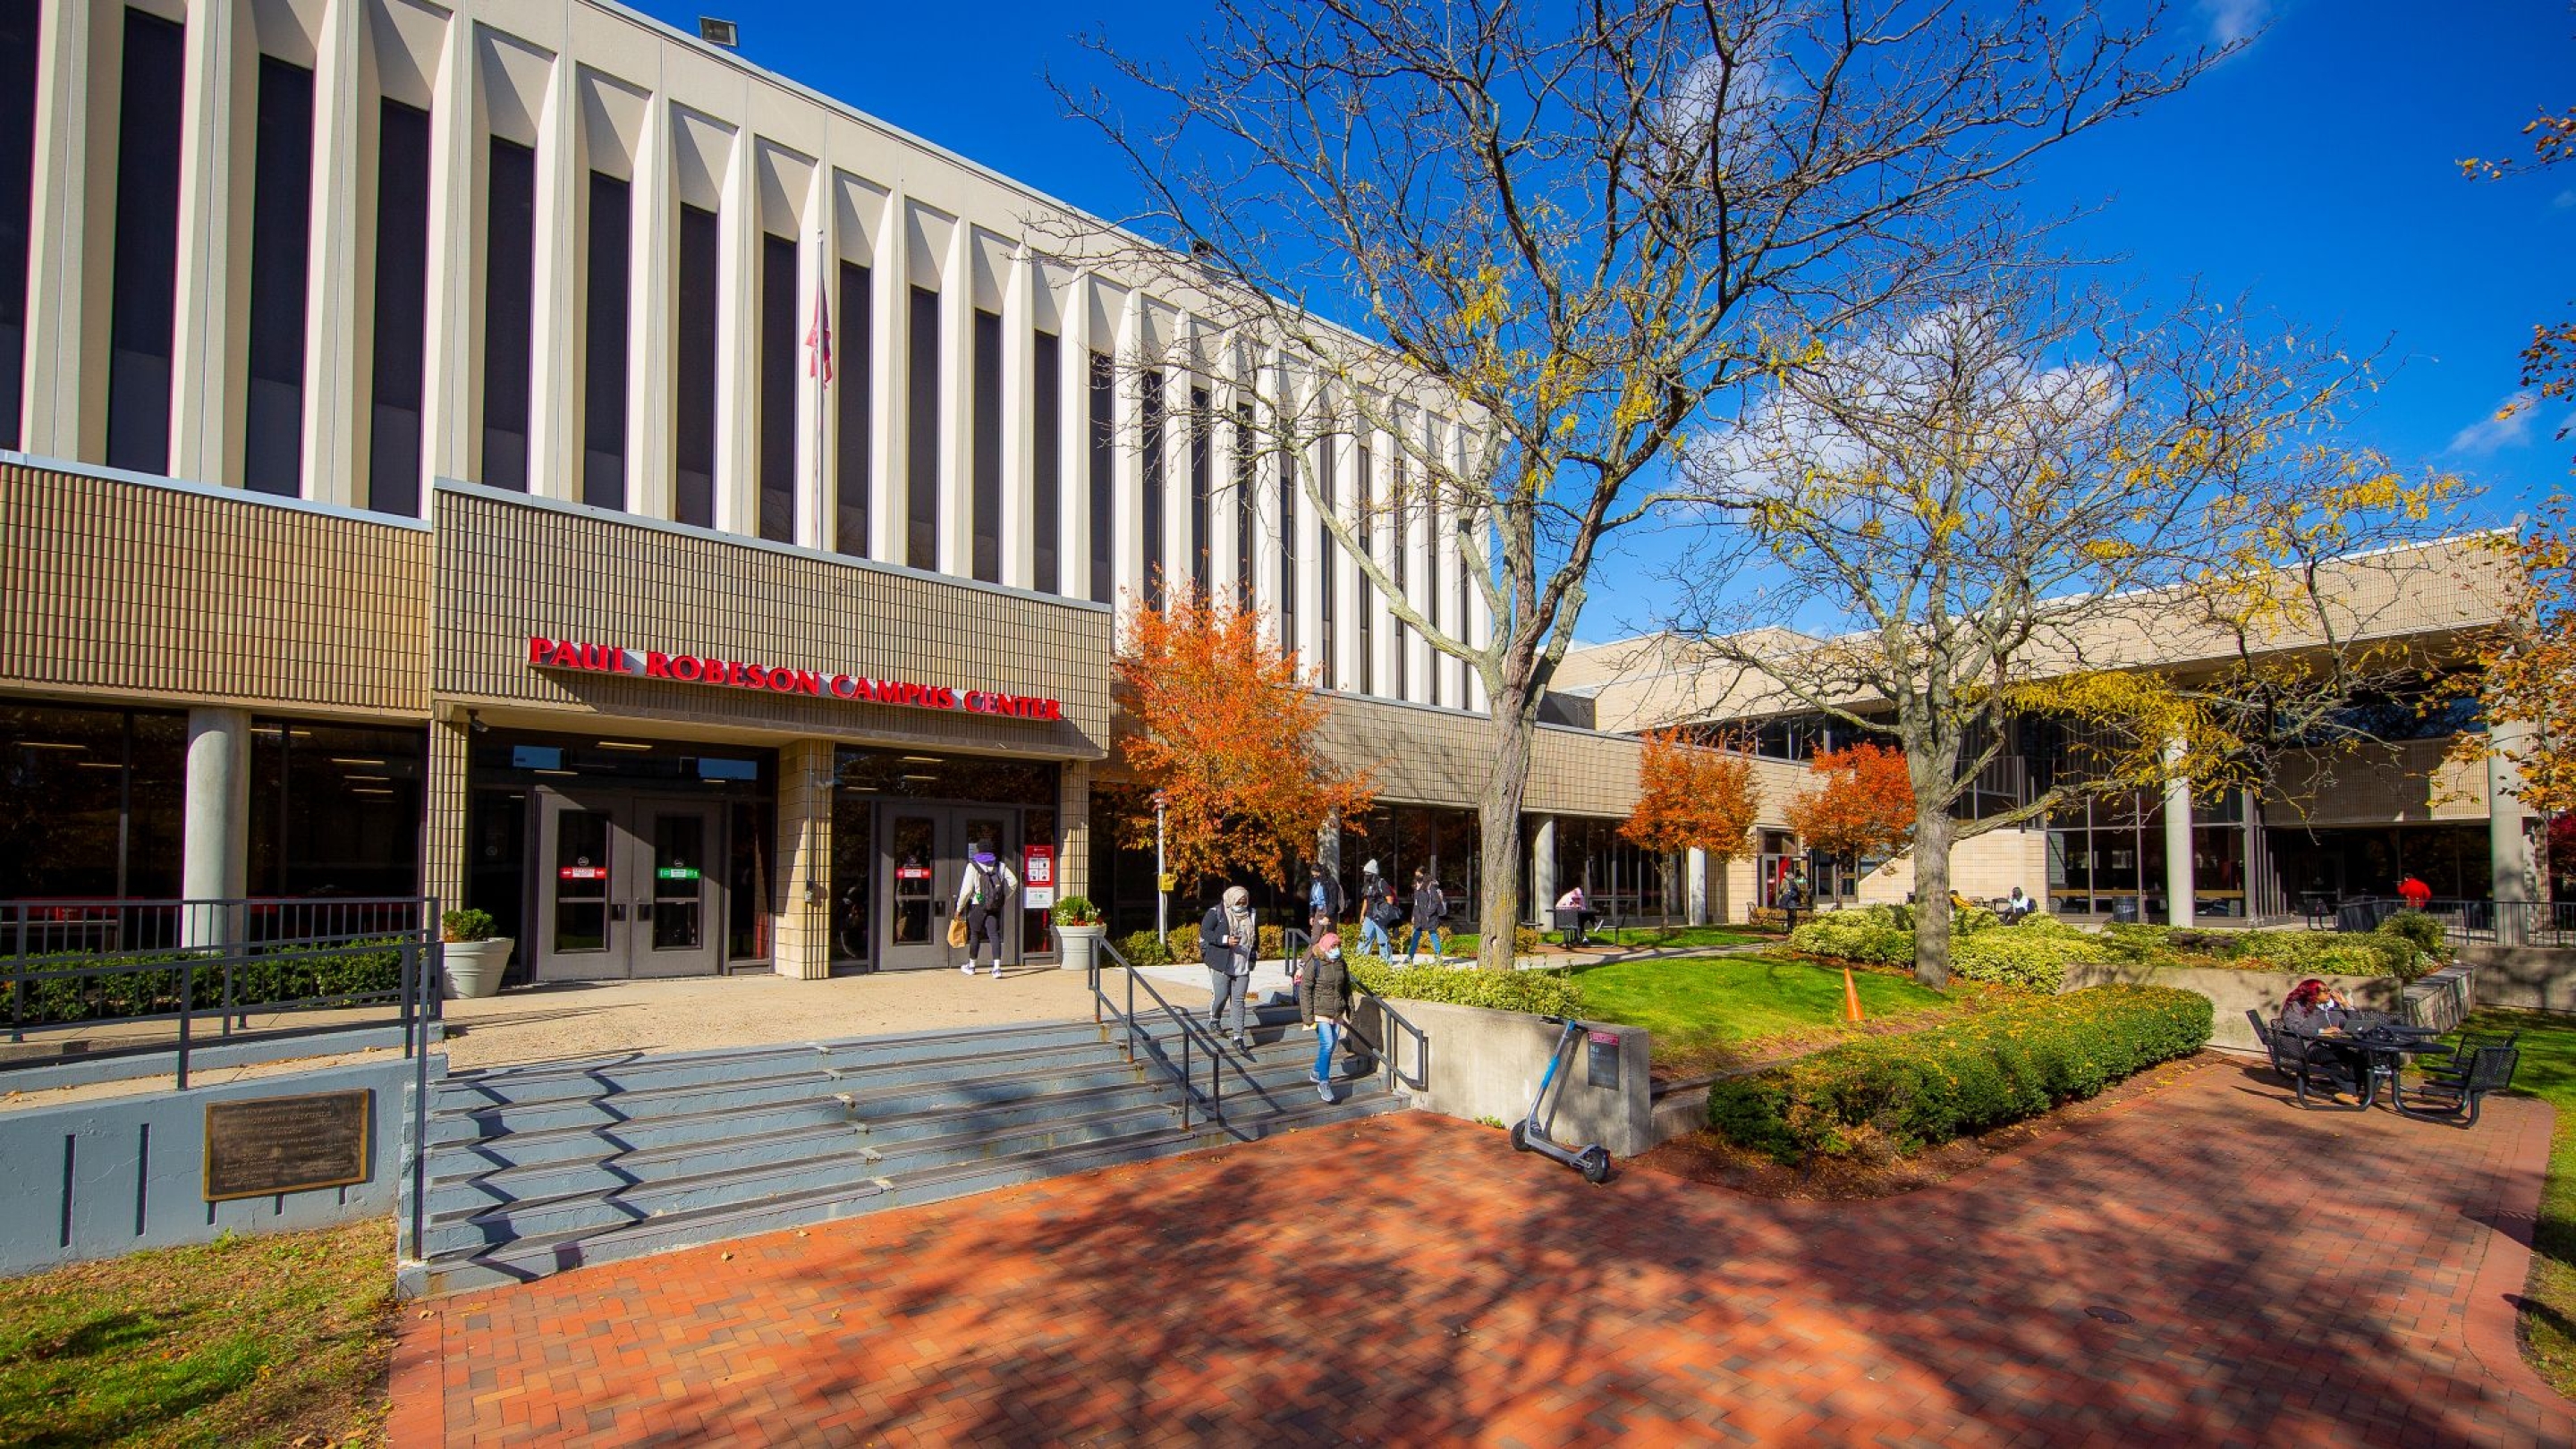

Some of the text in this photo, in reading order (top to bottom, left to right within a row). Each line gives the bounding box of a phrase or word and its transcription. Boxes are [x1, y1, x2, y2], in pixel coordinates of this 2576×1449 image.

[529, 637, 1062, 721] PAUL ROBESON CAMPUS CENTER
